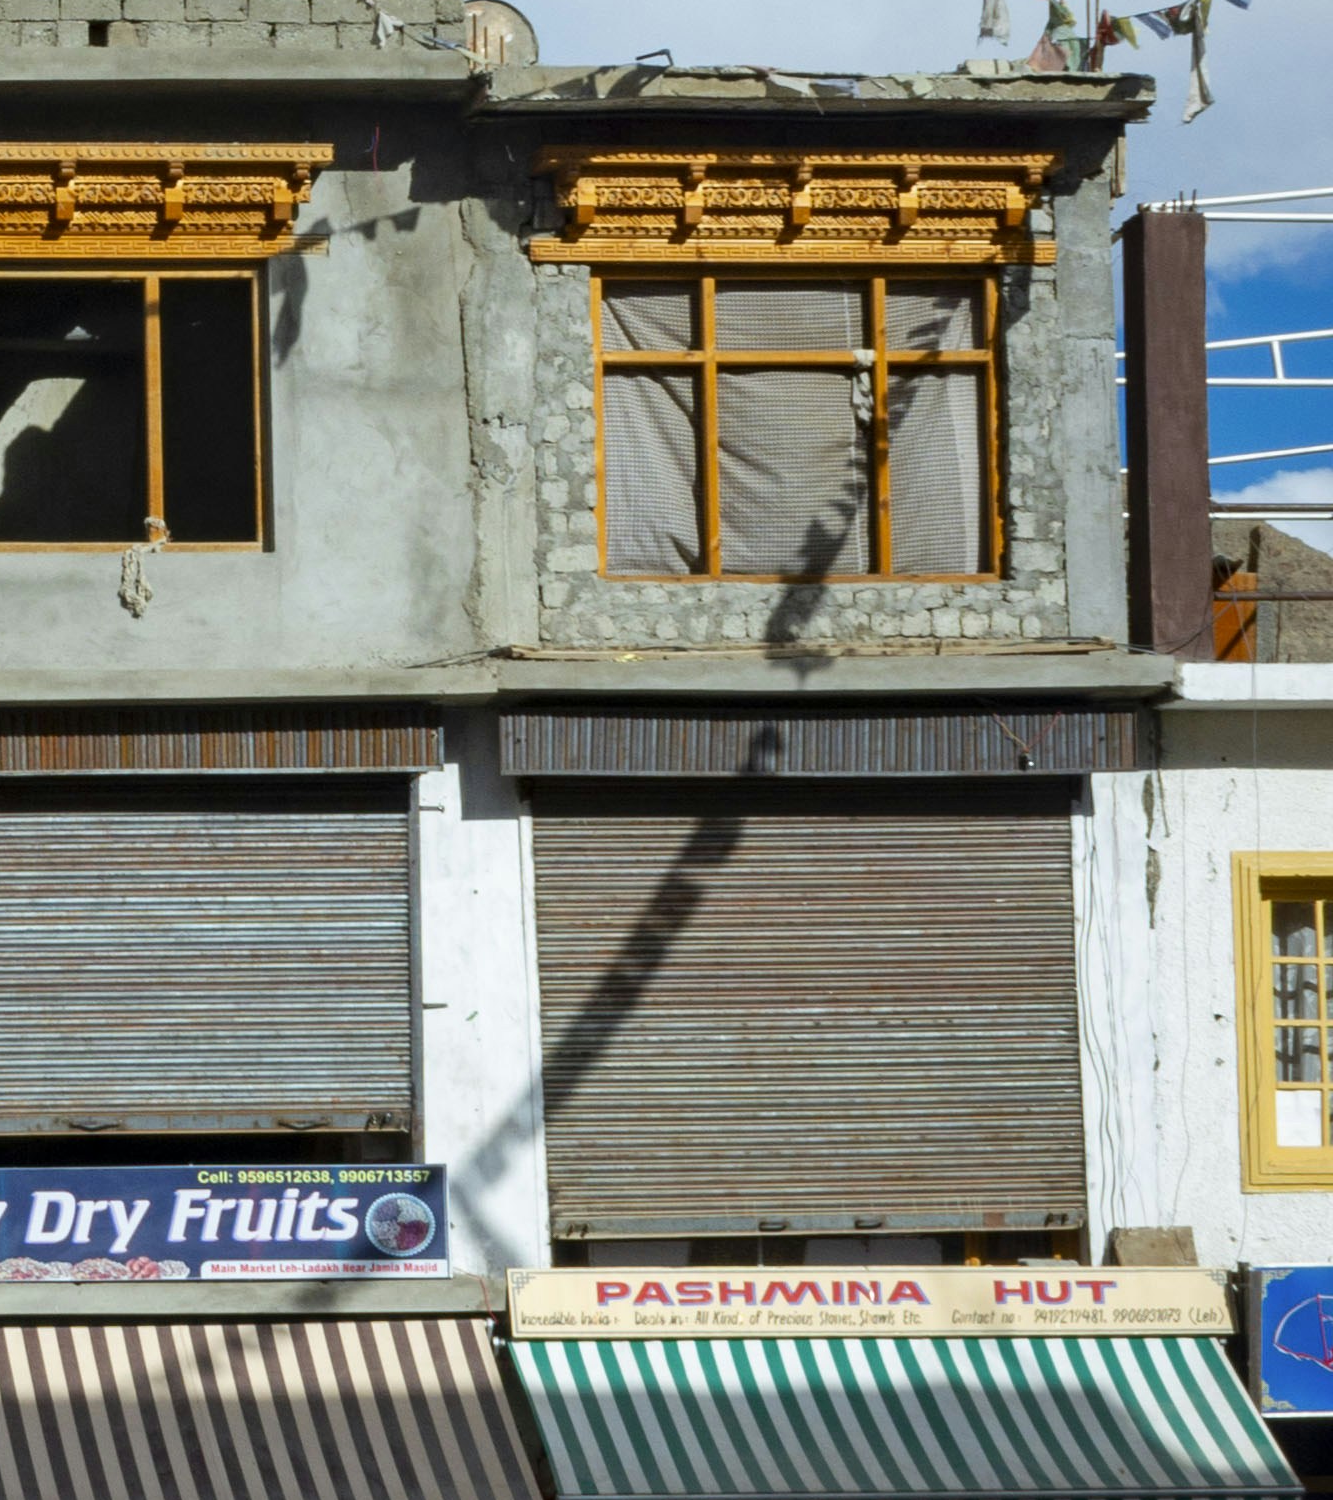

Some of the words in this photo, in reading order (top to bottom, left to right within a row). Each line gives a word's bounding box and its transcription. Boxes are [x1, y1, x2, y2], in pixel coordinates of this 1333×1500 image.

[197, 1171, 233, 1184] Cell:
[238, 1170, 335, 1186] 9596512638,
[339, 1169, 431, 1184] 9906713557
[23, 1190, 151, 1254] Dry
[167, 1187, 360, 1243] Fruits
[211, 1263, 237, 1274] Main
[240, 1263, 276, 1274] Market
[342, 1262, 366, 1274] Near
[404, 1262, 439, 1275] Masjid
[595, 1280, 931, 1307] PASHMINA
[993, 1279, 1118, 1306] HUT
[520, 1311, 577, 1326] Incredible
[634, 1310, 666, 1326] Deals
[694, 1310, 709, 1325] All
[749, 1309, 761, 1325] of
[767, 1309, 813, 1326] Precious
[951, 1309, 996, 1325] Contact
[1187, 1306, 1226, 1326] (Leh)
